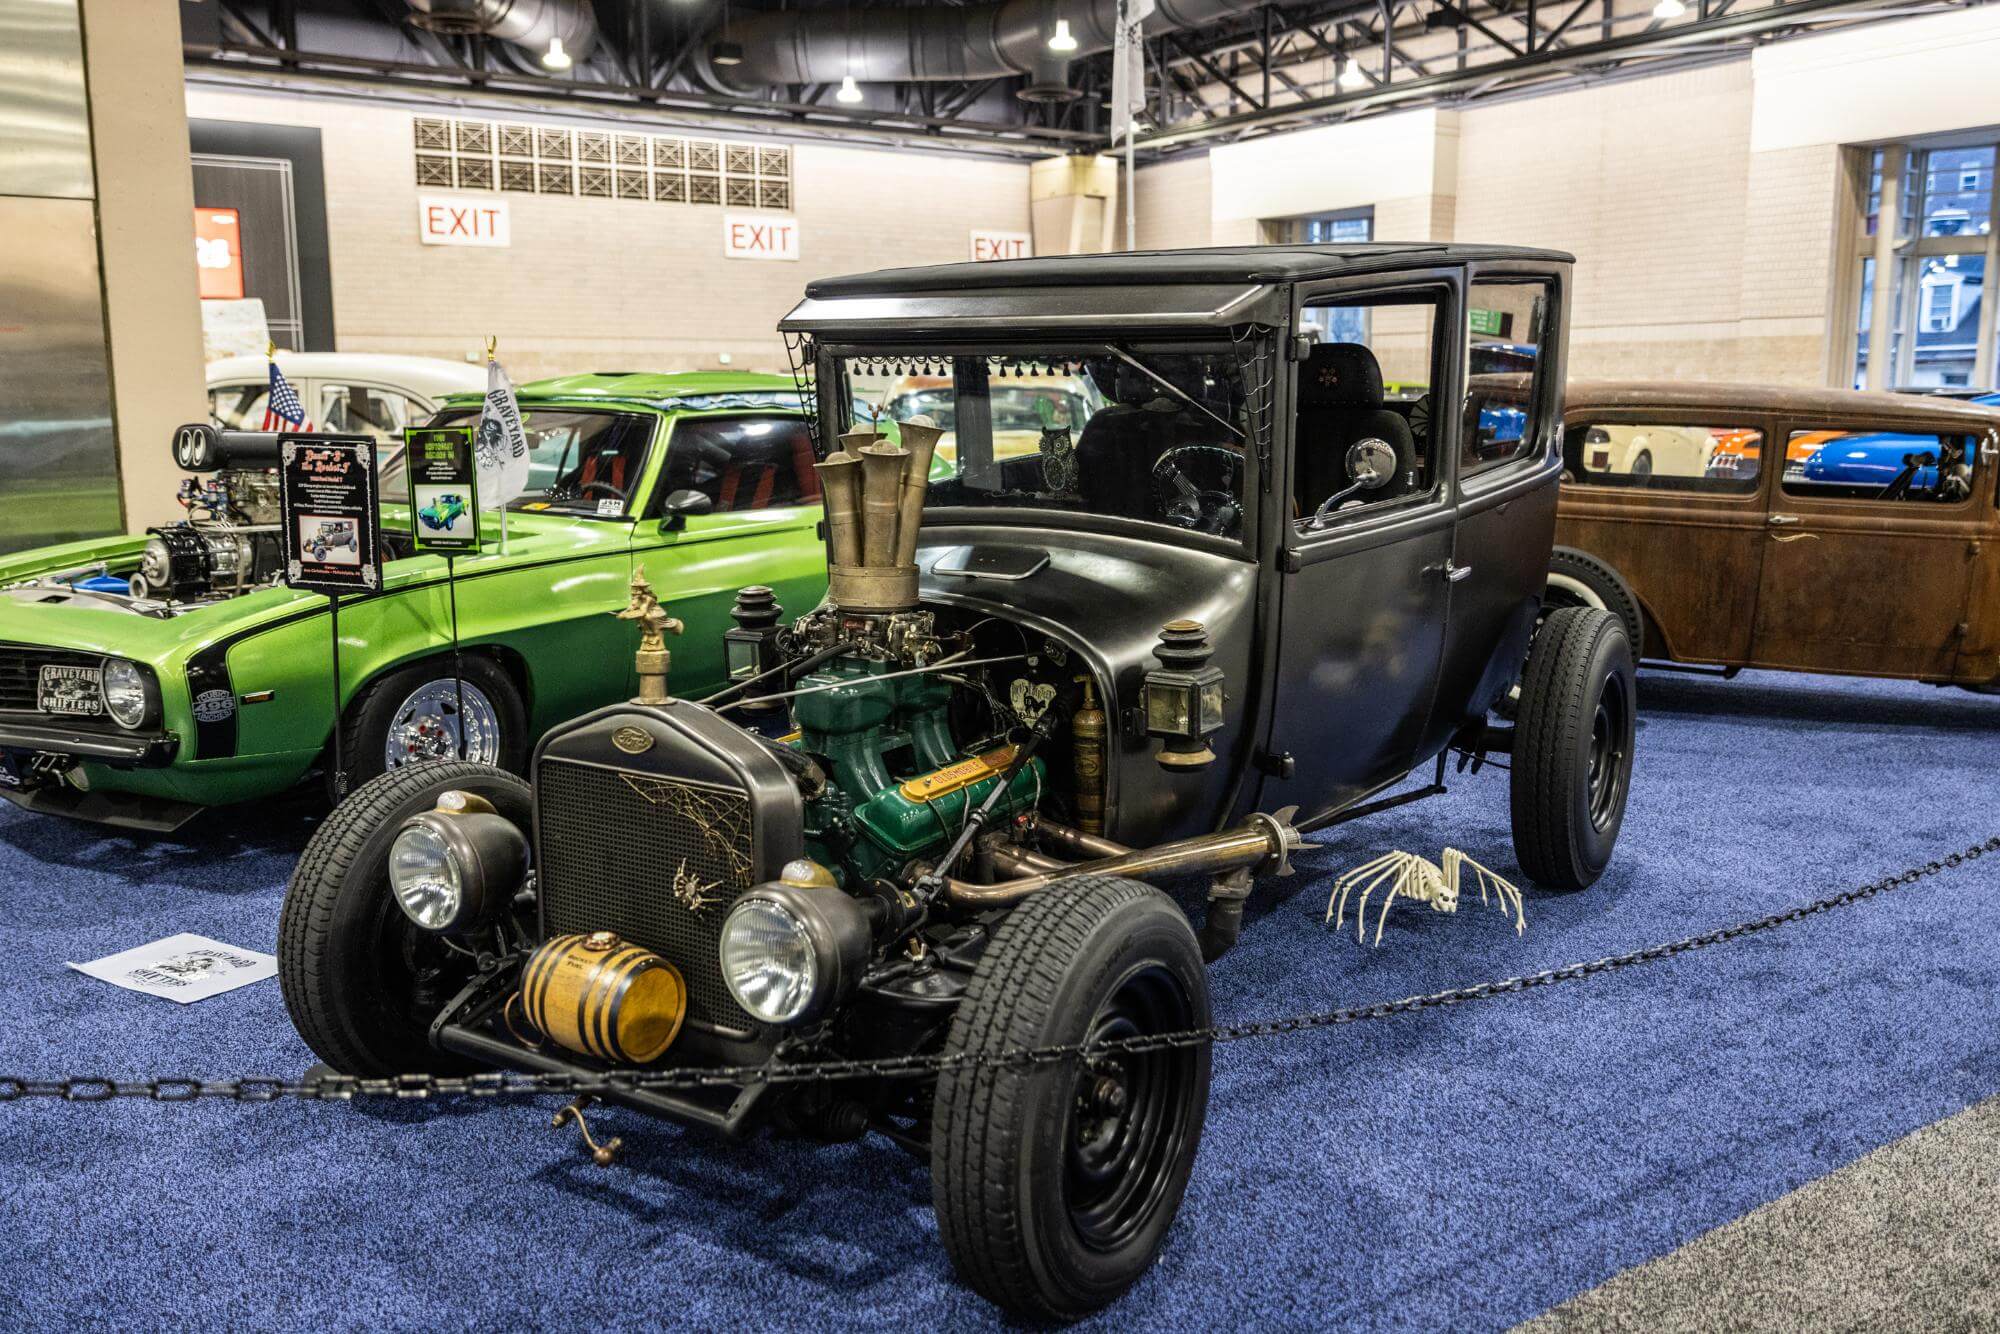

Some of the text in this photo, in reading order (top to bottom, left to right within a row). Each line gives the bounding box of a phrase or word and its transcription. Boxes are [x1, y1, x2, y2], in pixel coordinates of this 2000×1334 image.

[428, 206, 500, 237] EXIT
[732, 224, 792, 252] EXIT
[975, 238, 1025, 261] EXIT
[487, 388, 525, 459] GRAVEYARD
[43, 667, 100, 684] GRAVEYARD
[42, 696, 99, 710] SHIFTERS
[194, 700, 234, 713] 496
